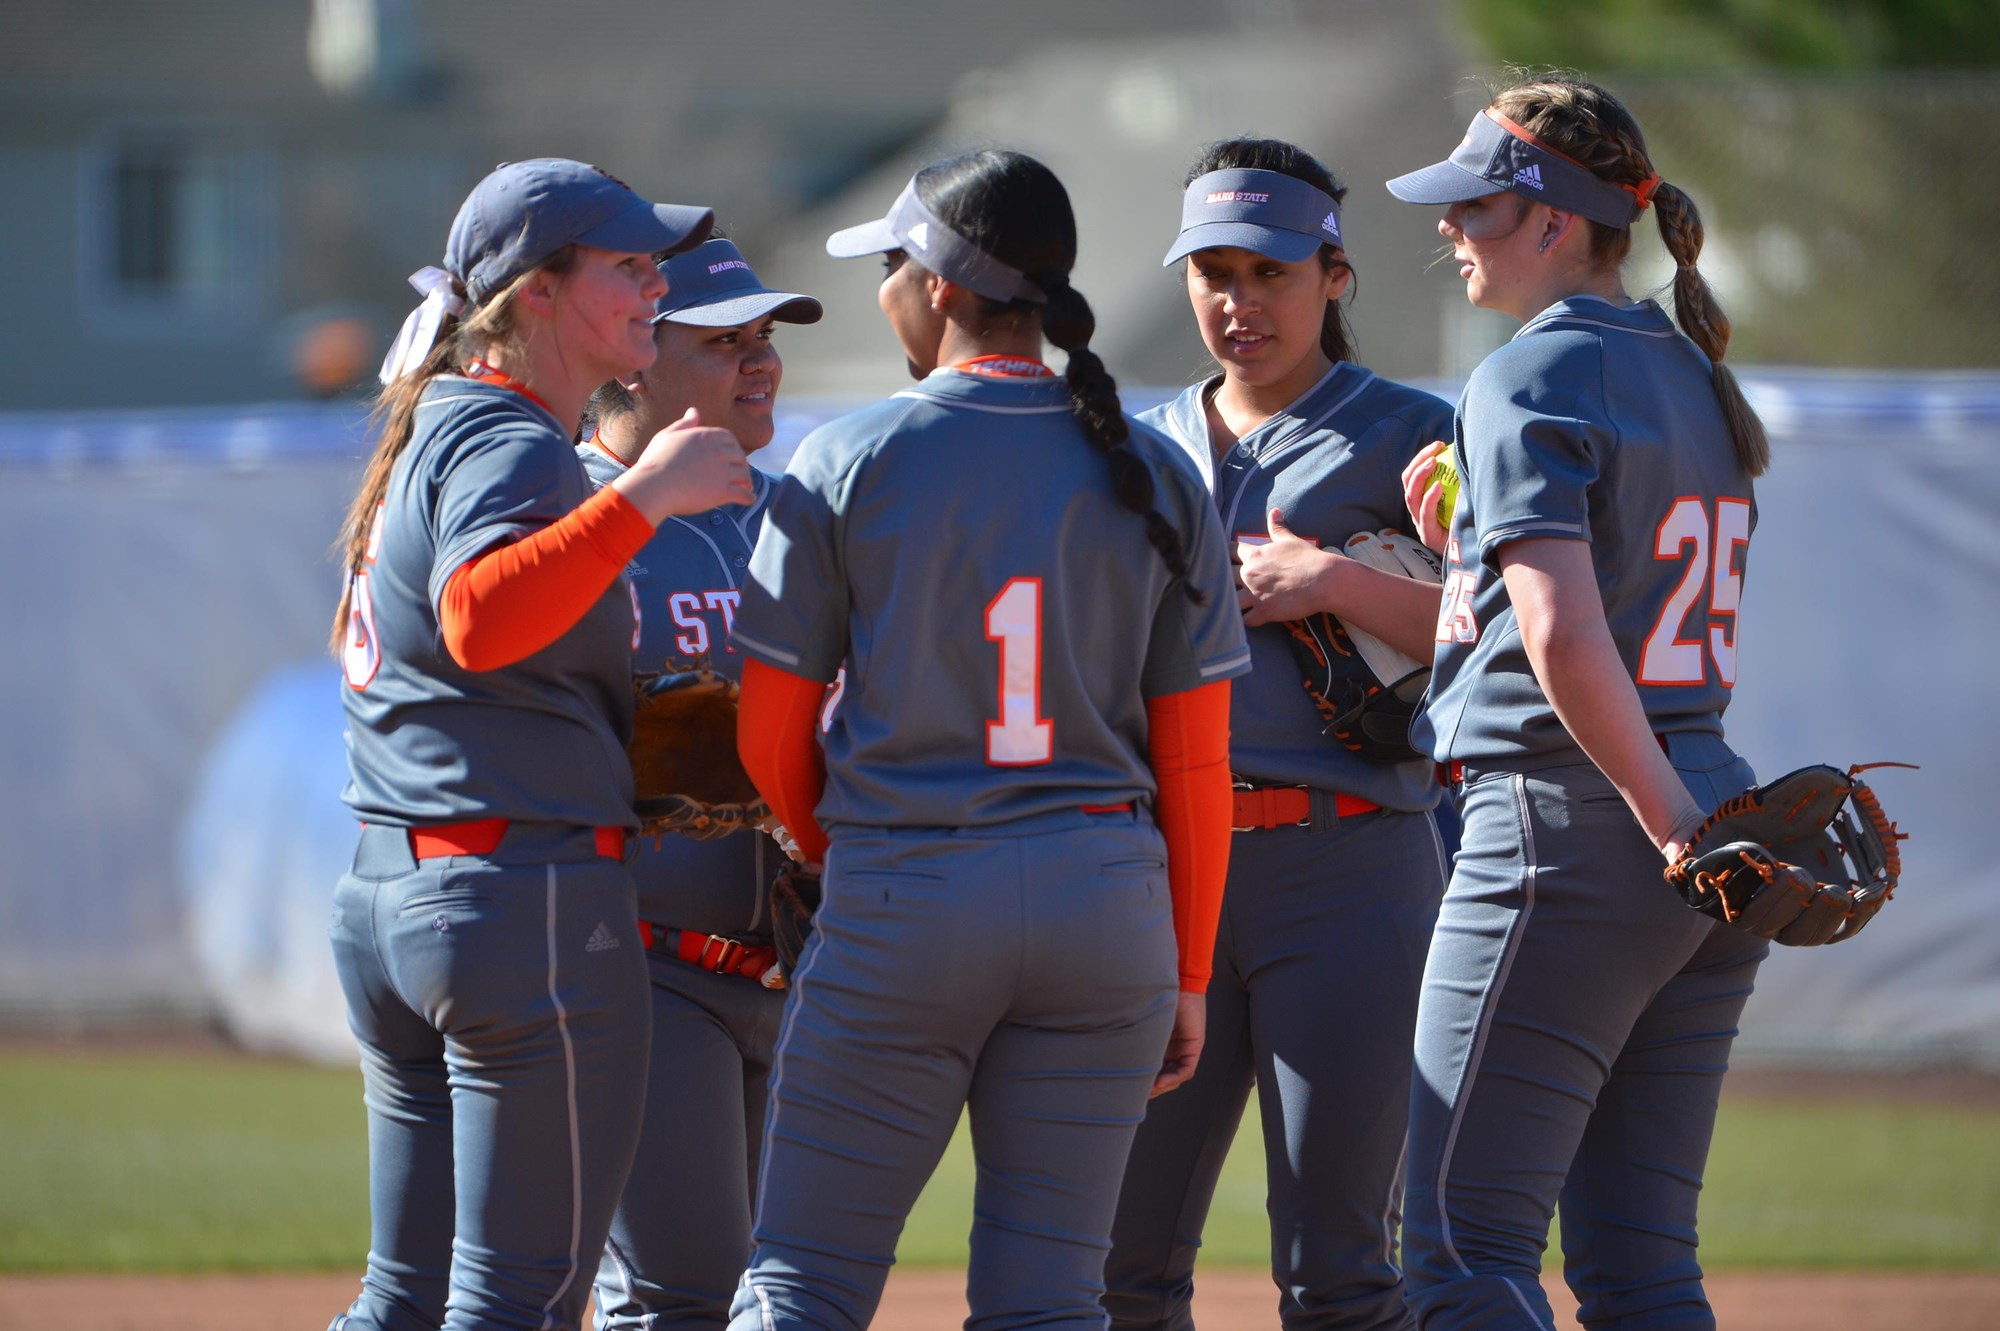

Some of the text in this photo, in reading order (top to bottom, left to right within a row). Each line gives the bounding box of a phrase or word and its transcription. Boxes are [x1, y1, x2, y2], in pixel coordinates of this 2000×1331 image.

[1235, 191, 1271, 204] STATE
[1513, 172, 1544, 191] adidas
[707, 260, 736, 275] IDAHO
[1412, 547, 1443, 582] EAS
[1434, 569, 1479, 643] 25
[1635, 495, 1751, 689] 25
[984, 576, 1054, 768] 1
